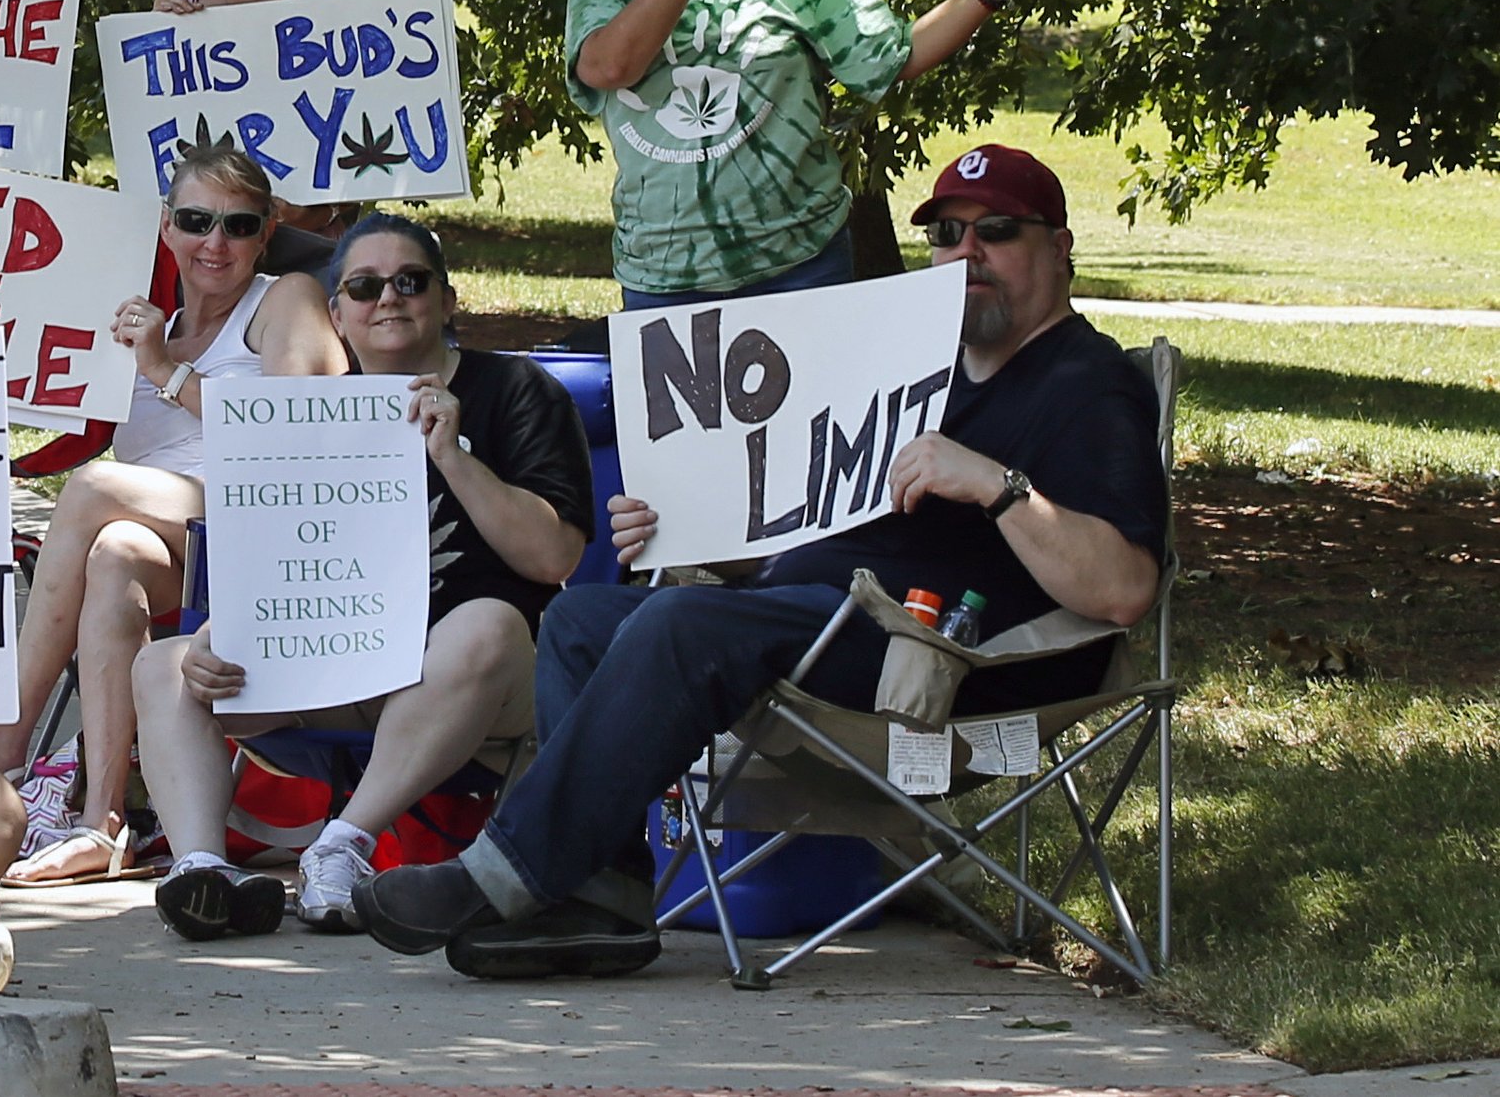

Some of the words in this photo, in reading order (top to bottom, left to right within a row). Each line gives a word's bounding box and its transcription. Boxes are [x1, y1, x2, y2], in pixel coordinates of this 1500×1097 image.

[121, 26, 250, 97] THIS
[274, 7, 440, 81] BUD'S
[618, 121, 654, 158] LEGALIZE
[652, 146, 706, 164] CANNABIS
[706, 144, 728, 161] FOR
[638, 308, 791, 442] NO
[221, 397, 275, 426] NO
[285, 394, 403, 425] LIMITS
[744, 364, 953, 544] LIMIT
[222, 483, 304, 508] HIGH
[312, 479, 409, 506] DOSES
[296, 520, 337, 544] OF
[278, 557, 367, 583] THCA
[255, 592, 386, 622] SHRINKS
[256, 628, 386, 660] TUMORS
